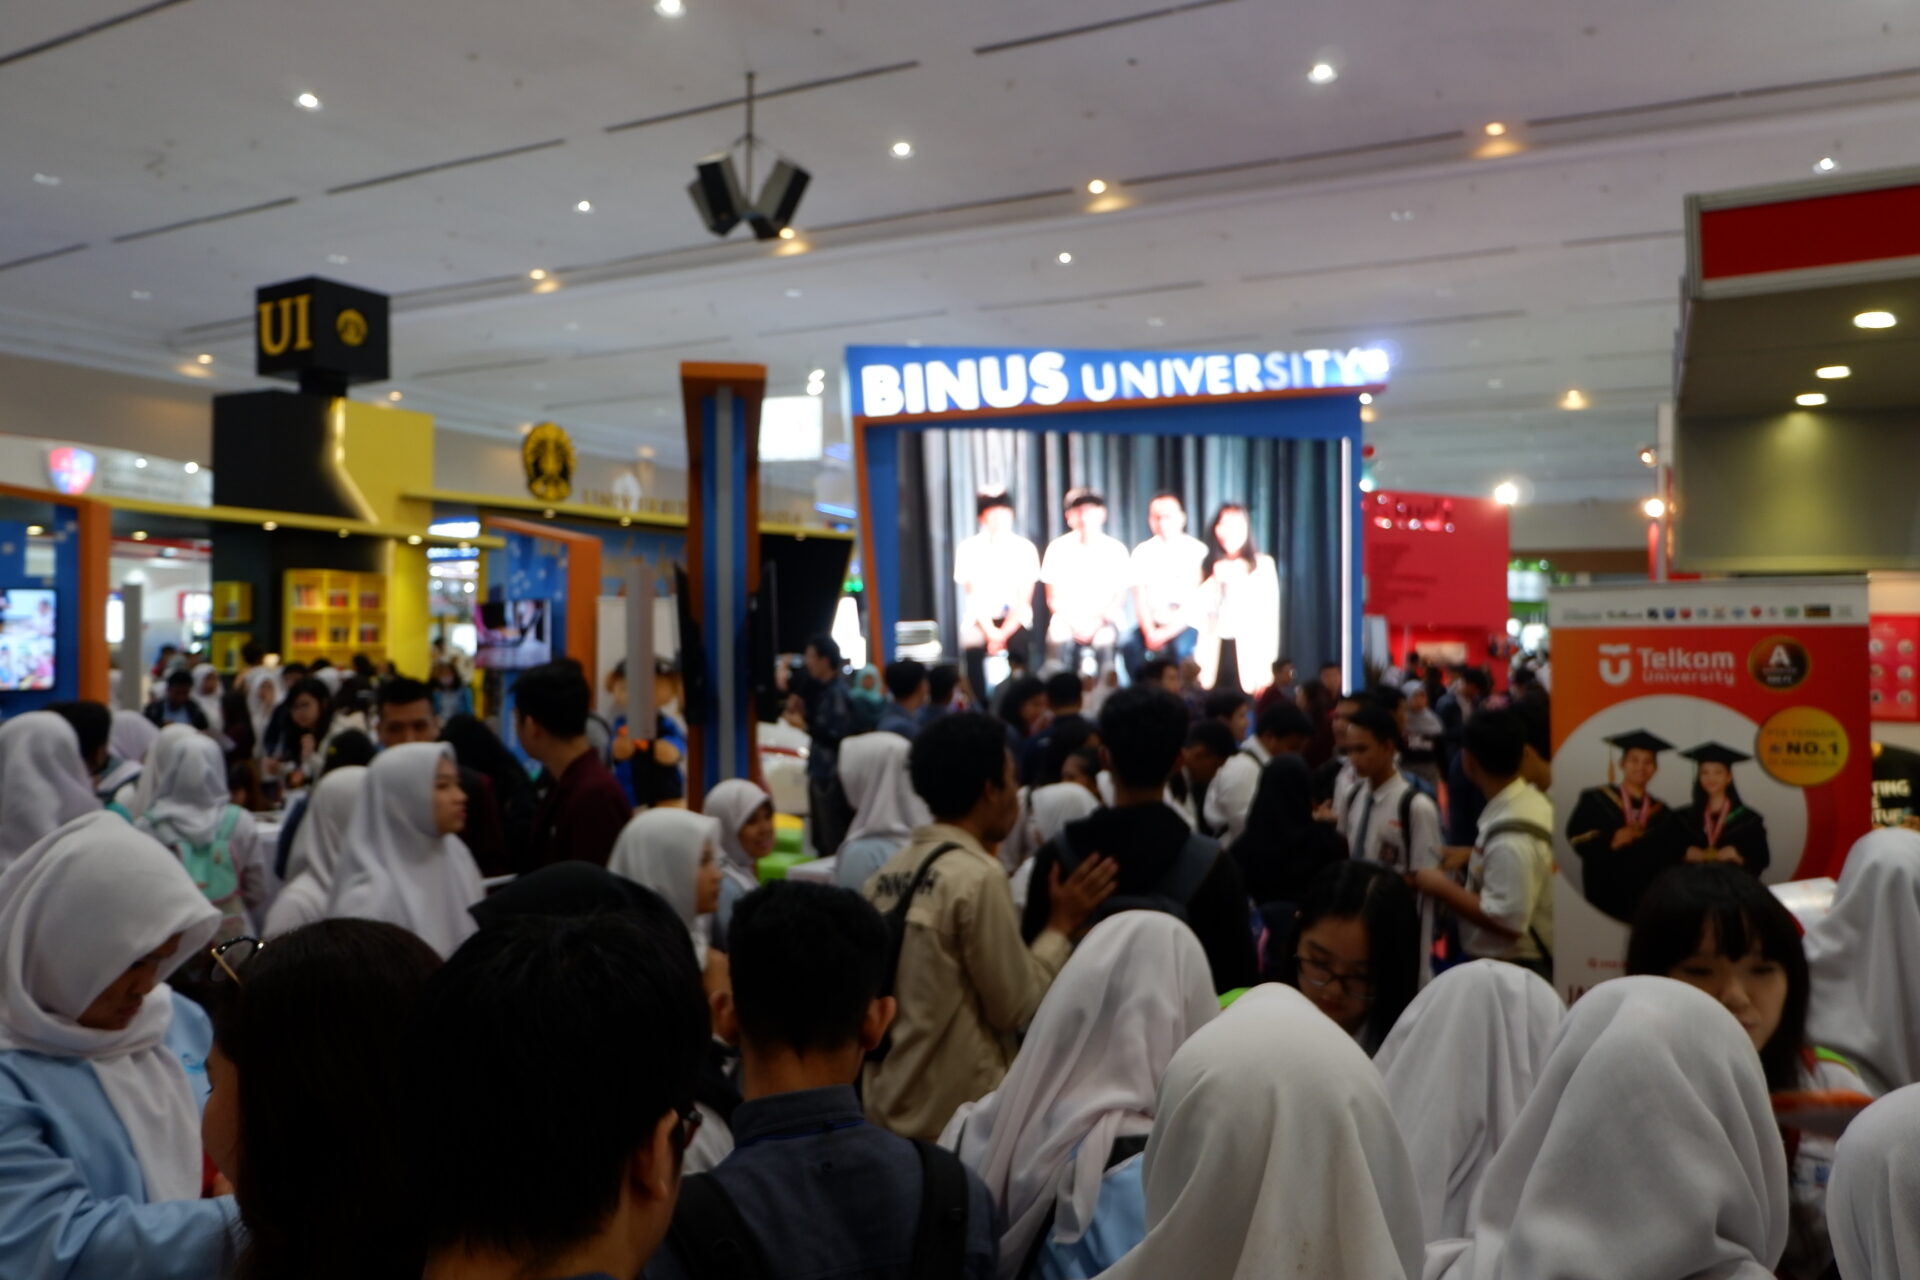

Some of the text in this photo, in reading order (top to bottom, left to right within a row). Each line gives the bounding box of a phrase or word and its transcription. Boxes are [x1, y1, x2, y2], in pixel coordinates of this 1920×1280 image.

[257, 293, 313, 356] UI
[861, 347, 1363, 417] BINUS UNIVERSITY
[1637, 647, 1735, 670] Telkom
[1768, 645, 1791, 666] A
[1642, 669, 1736, 687] University
